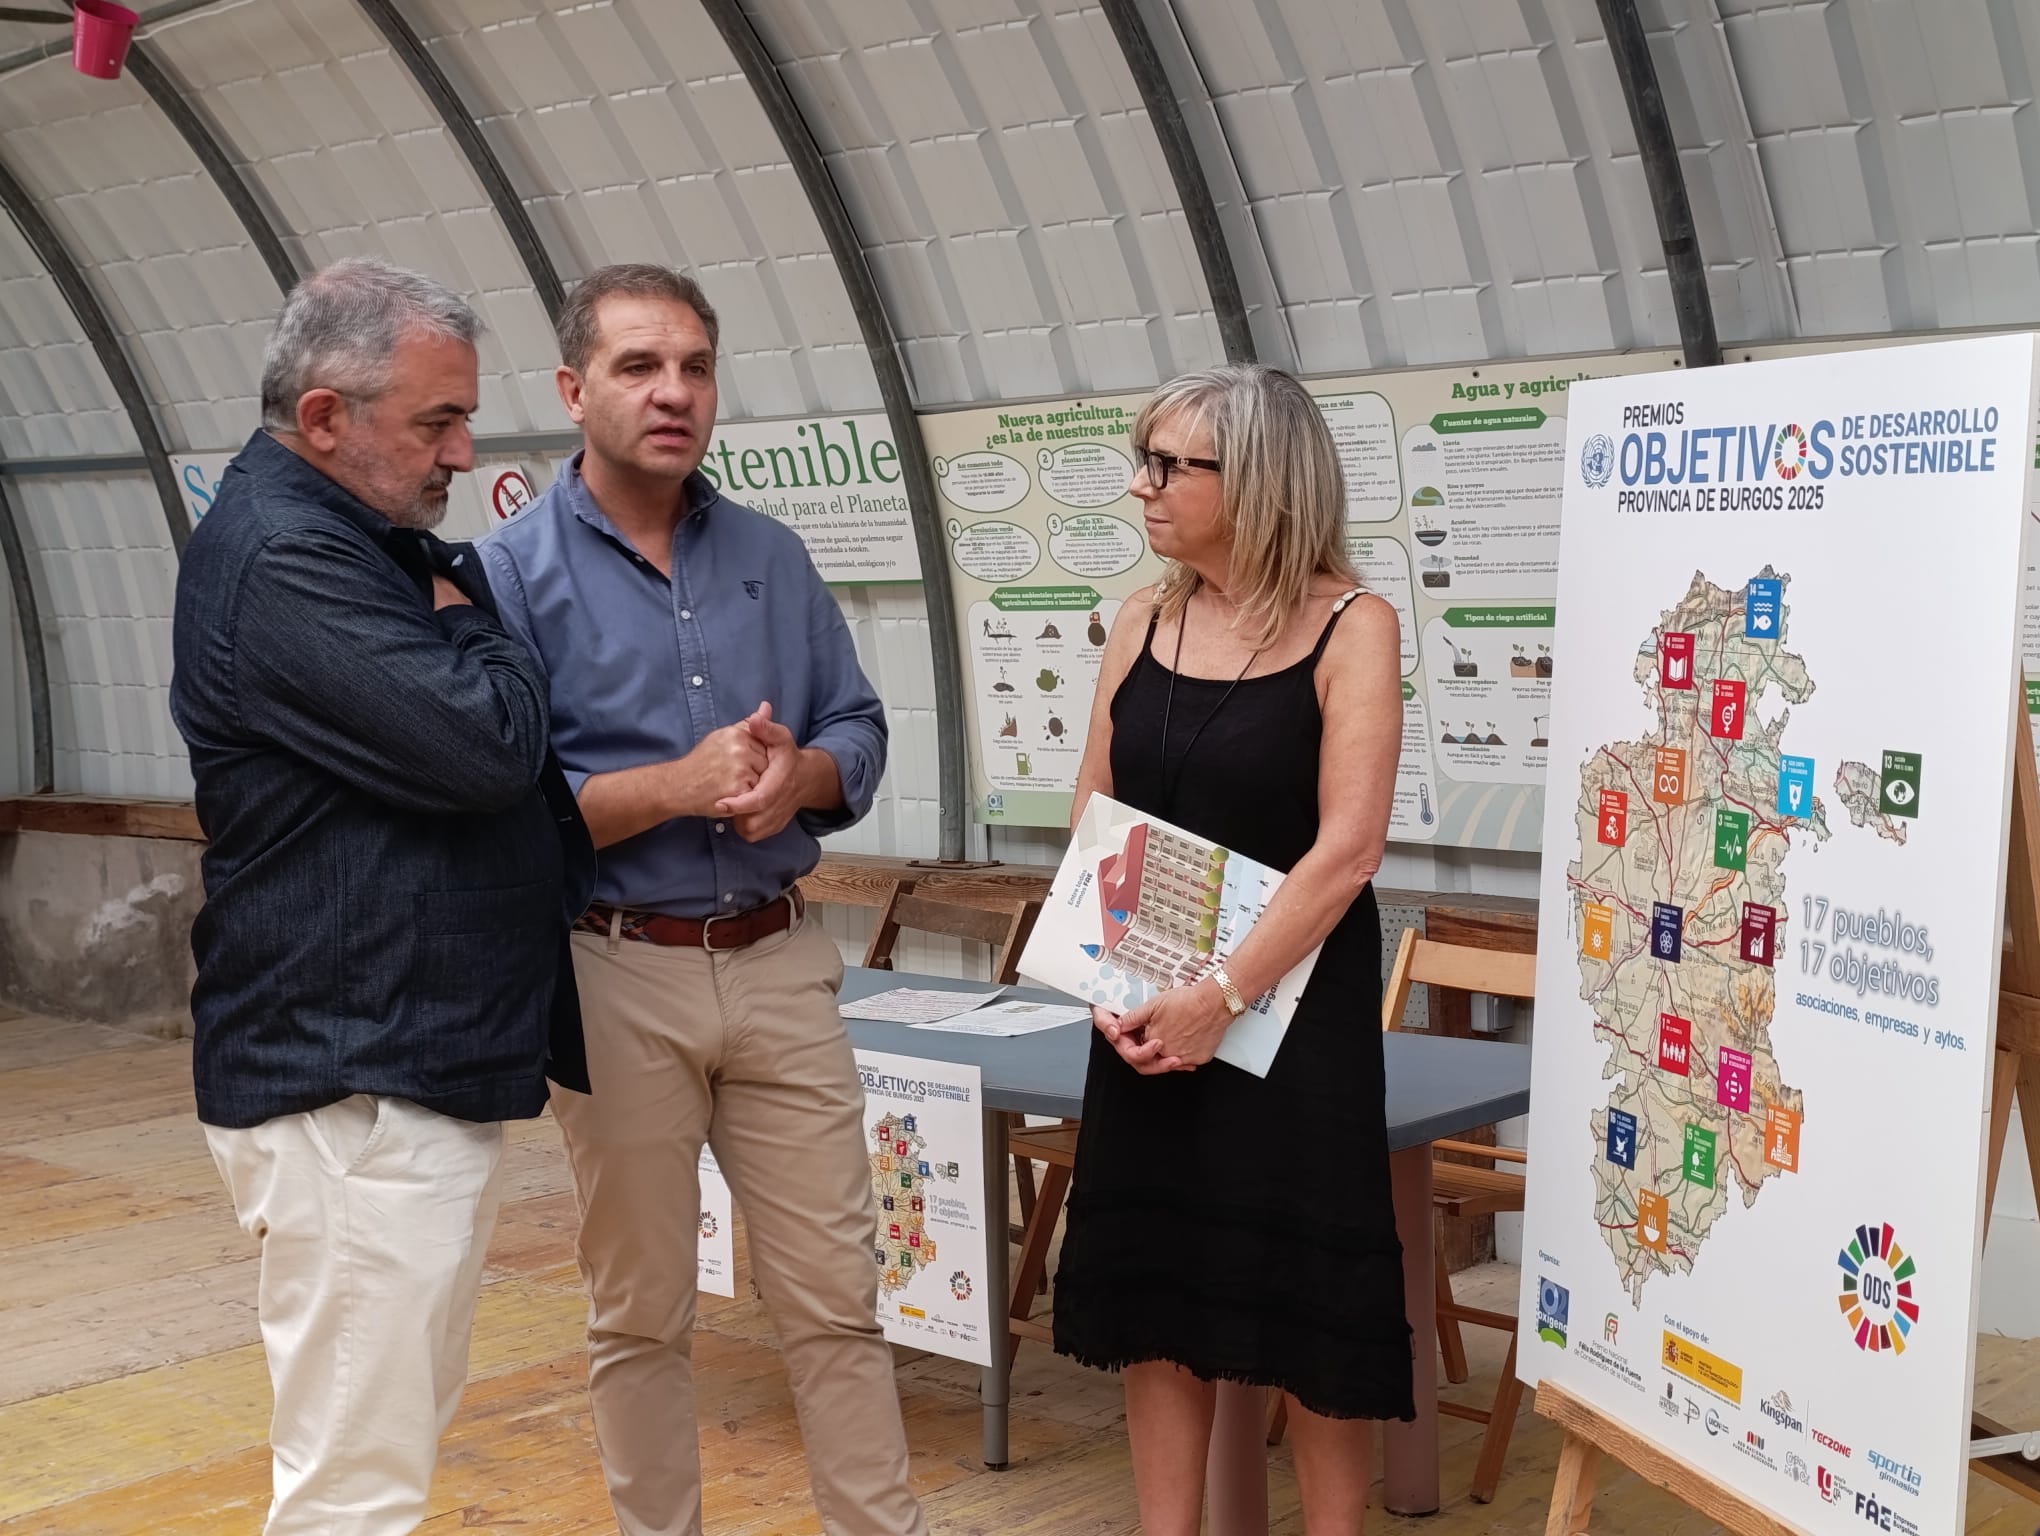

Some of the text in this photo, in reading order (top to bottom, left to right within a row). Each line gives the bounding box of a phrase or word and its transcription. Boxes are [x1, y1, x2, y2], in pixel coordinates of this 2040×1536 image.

[1451, 383, 1500, 401] Agua
[1504, 383, 1515, 399] y
[998, 414, 1043, 428] Nueva
[1443, 414, 1537, 427] Fuentes de agua naturales
[1624, 402, 1684, 428] PREMIOS
[1841, 406, 1998, 440] DE DESARROLLO
[985, 420, 1132, 449] ¿es la de nuestros abu
[698, 421, 900, 491] stenible
[1042, 454, 1048, 463] 2
[1619, 420, 1836, 486] OBJETIVOS
[1840, 439, 1997, 477] SOSTENIBLE
[938, 462, 943, 471] 1
[1618, 485, 1824, 513] PROVINCIA DE BURGOS 2025
[792, 501, 827, 520] para
[831, 495, 845, 513] el
[847, 494, 908, 514] Planeta
[819, 521, 832, 529] toda
[874, 519, 908, 527] humanidad.
[952, 524, 957, 533] 4
[1052, 520, 1057, 528] 5
[861, 535, 885, 544] podemos
[817, 560, 824, 568] de
[1750, 584, 1756, 596] 14
[1464, 614, 1484, 622] Tipos
[1496, 614, 1515, 622] riego
[1516, 613, 1548, 621] artificial
[1666, 637, 1671, 648] 4
[1715, 685, 1720, 697] 5
[1657, 751, 1663, 763] 12
[1884, 755, 1892, 769] 13
[1782, 761, 1787, 772] 6
[1601, 793, 1605, 805] 9
[1718, 814, 1723, 826] 3
[1068, 870, 1087, 906] Entre todos
[1075, 888, 1086, 908] somos
[1655, 906, 1660, 918] 17
[1745, 906, 1749, 919] 8
[1803, 895, 1829, 931] 17
[1832, 908, 1935, 962] pueblos,
[1800, 940, 1940, 1006] 17 objetivos
[1662, 1018, 1665, 1029] 1
[1865, 1010, 1919, 1038] empresas
[1923, 1027, 1931, 1044] y
[1935, 1030, 1967, 1051] aytos.
[1721, 1051, 1728, 1064] 10
[857, 1064, 879, 1073] PREMIOS
[859, 1072, 926, 1095] OBJETIVOS
[928, 1089, 970, 1102] SOSTENIBLE
[1768, 1109, 1774, 1121] 11
[1686, 1128, 1692, 1140] 15
[929, 1195, 937, 1203] 17
[1641, 1193, 1645, 1205] 2
[930, 1205, 970, 1221] 17 objetivos
[1863, 1273, 1891, 1309] ODS
[1664, 1314, 1709, 1344] Con el apoyo de:
[1578, 1341, 1589, 1354] Félix
[1613, 1360, 1620, 1370] de
[1625, 1366, 1641, 1380] Fuente
[1760, 1398, 1802, 1433] Kingspan
[1812, 1429, 1851, 1458] TECZONE
[1867, 1449, 1922, 1487] sportia
[1880, 1471, 1919, 1496] gimnasios
